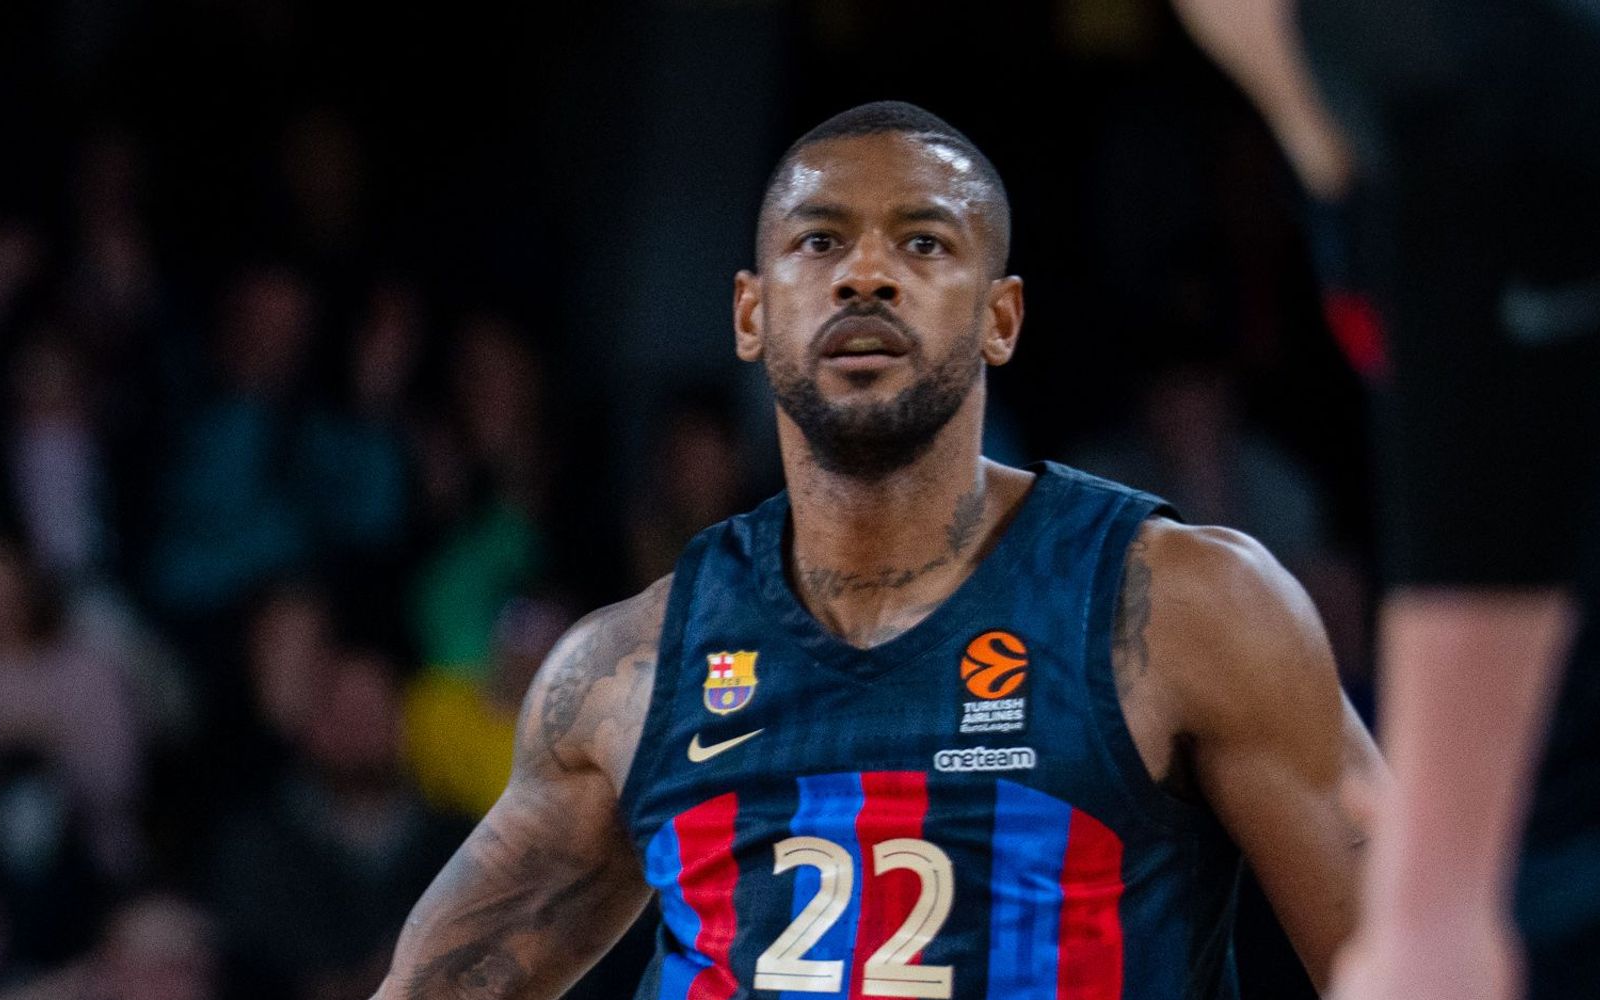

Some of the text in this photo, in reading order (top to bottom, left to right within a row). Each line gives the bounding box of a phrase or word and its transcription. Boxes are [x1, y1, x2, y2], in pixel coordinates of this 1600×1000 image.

[962, 698, 1025, 713] TURKISH
[961, 709, 1025, 724] AIRLINES
[936, 747, 1034, 770] oneteam
[753, 836, 954, 1000] 22
